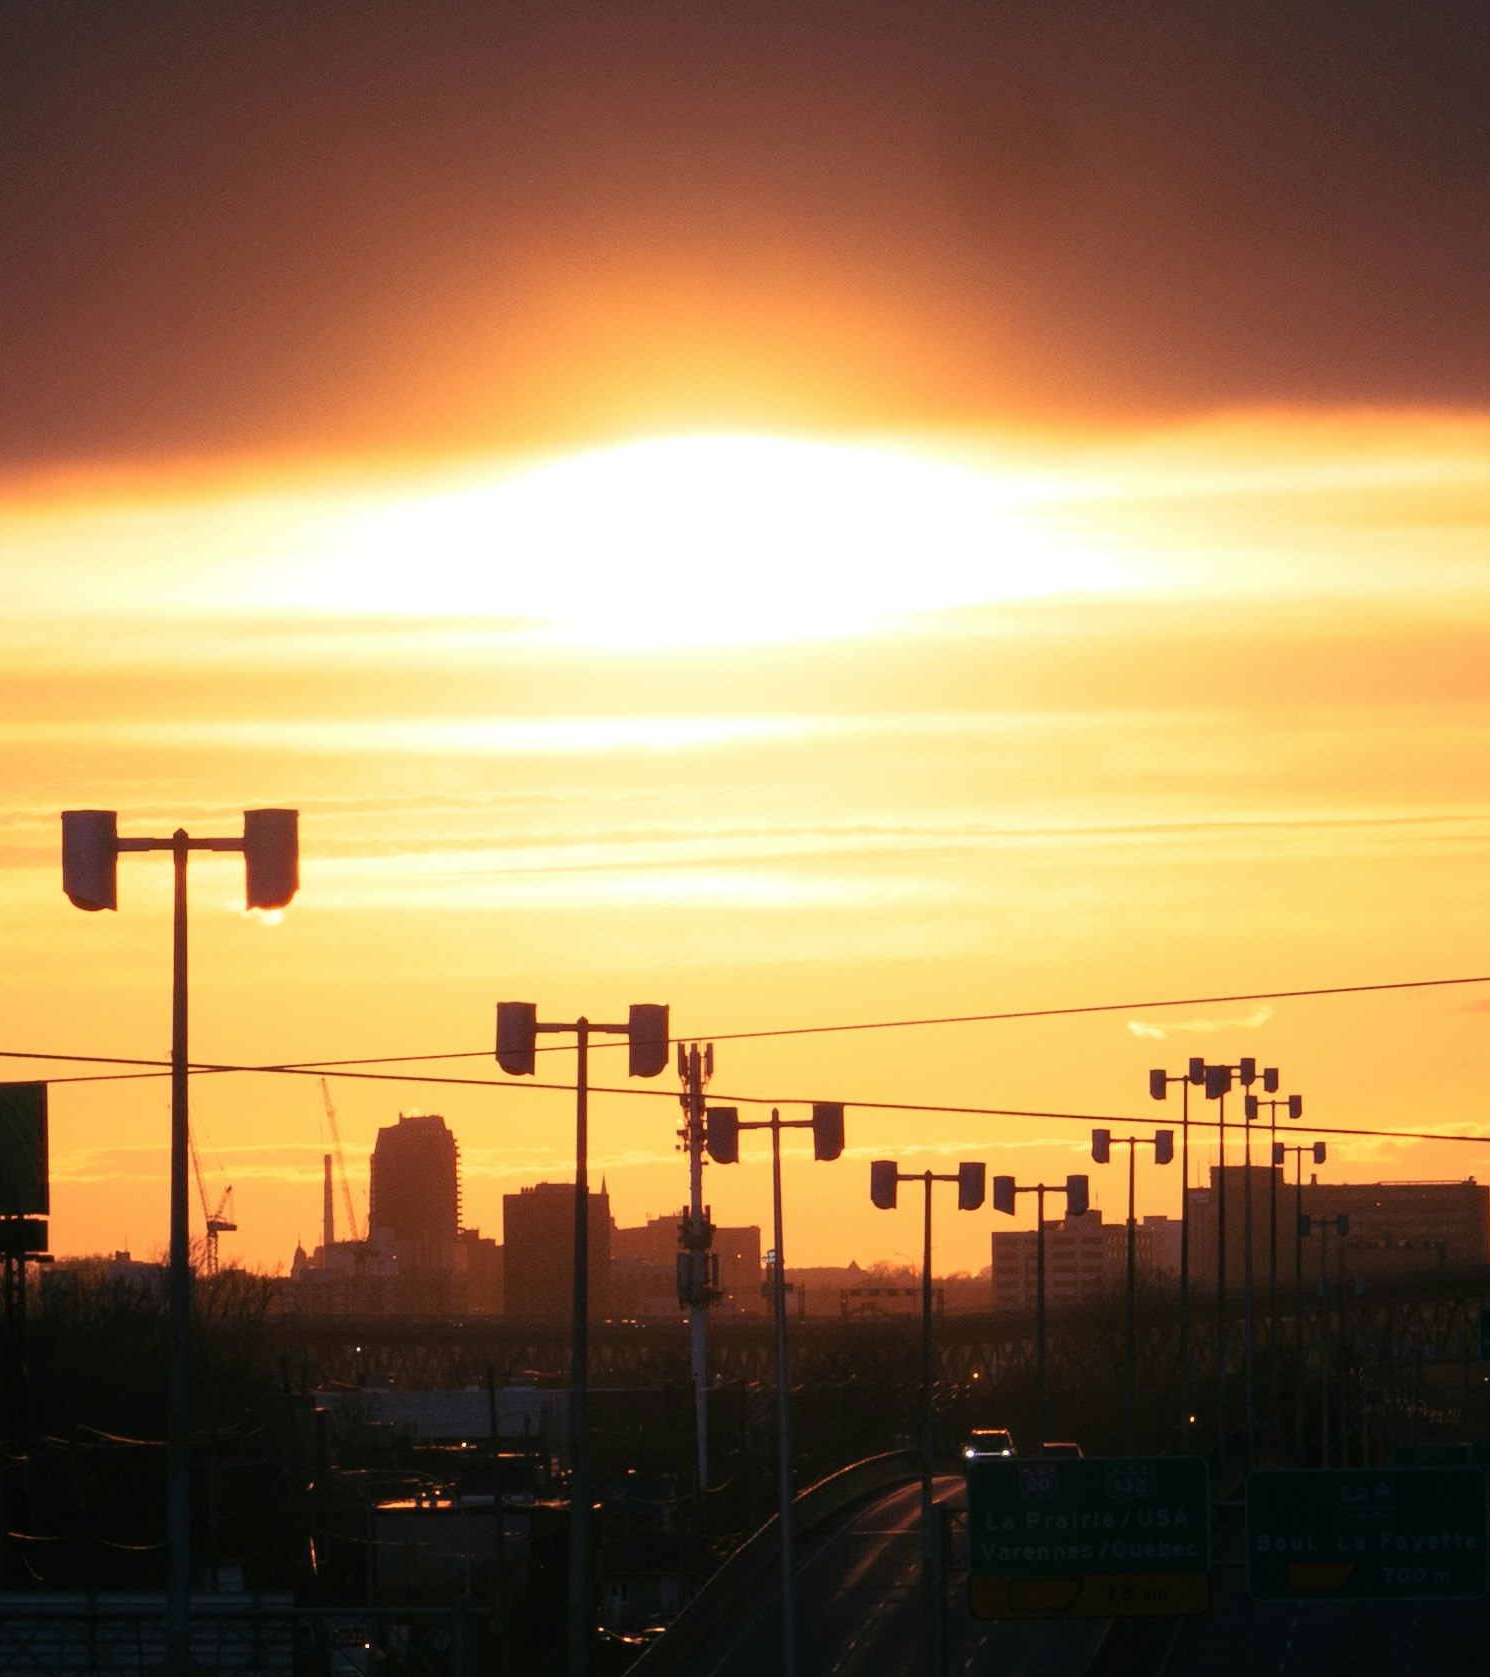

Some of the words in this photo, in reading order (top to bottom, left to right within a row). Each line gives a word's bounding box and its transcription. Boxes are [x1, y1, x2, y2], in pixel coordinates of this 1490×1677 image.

[1026, 1478, 1050, 1491] 20
[1114, 1479, 1146, 1493] 132
[986, 1513, 1015, 1530] La
[1337, 1533, 1366, 1550] La
[1380, 1531, 1478, 1554] Fayette
[1381, 1566, 1427, 1583] 700
[1434, 1570, 1450, 1583] m
